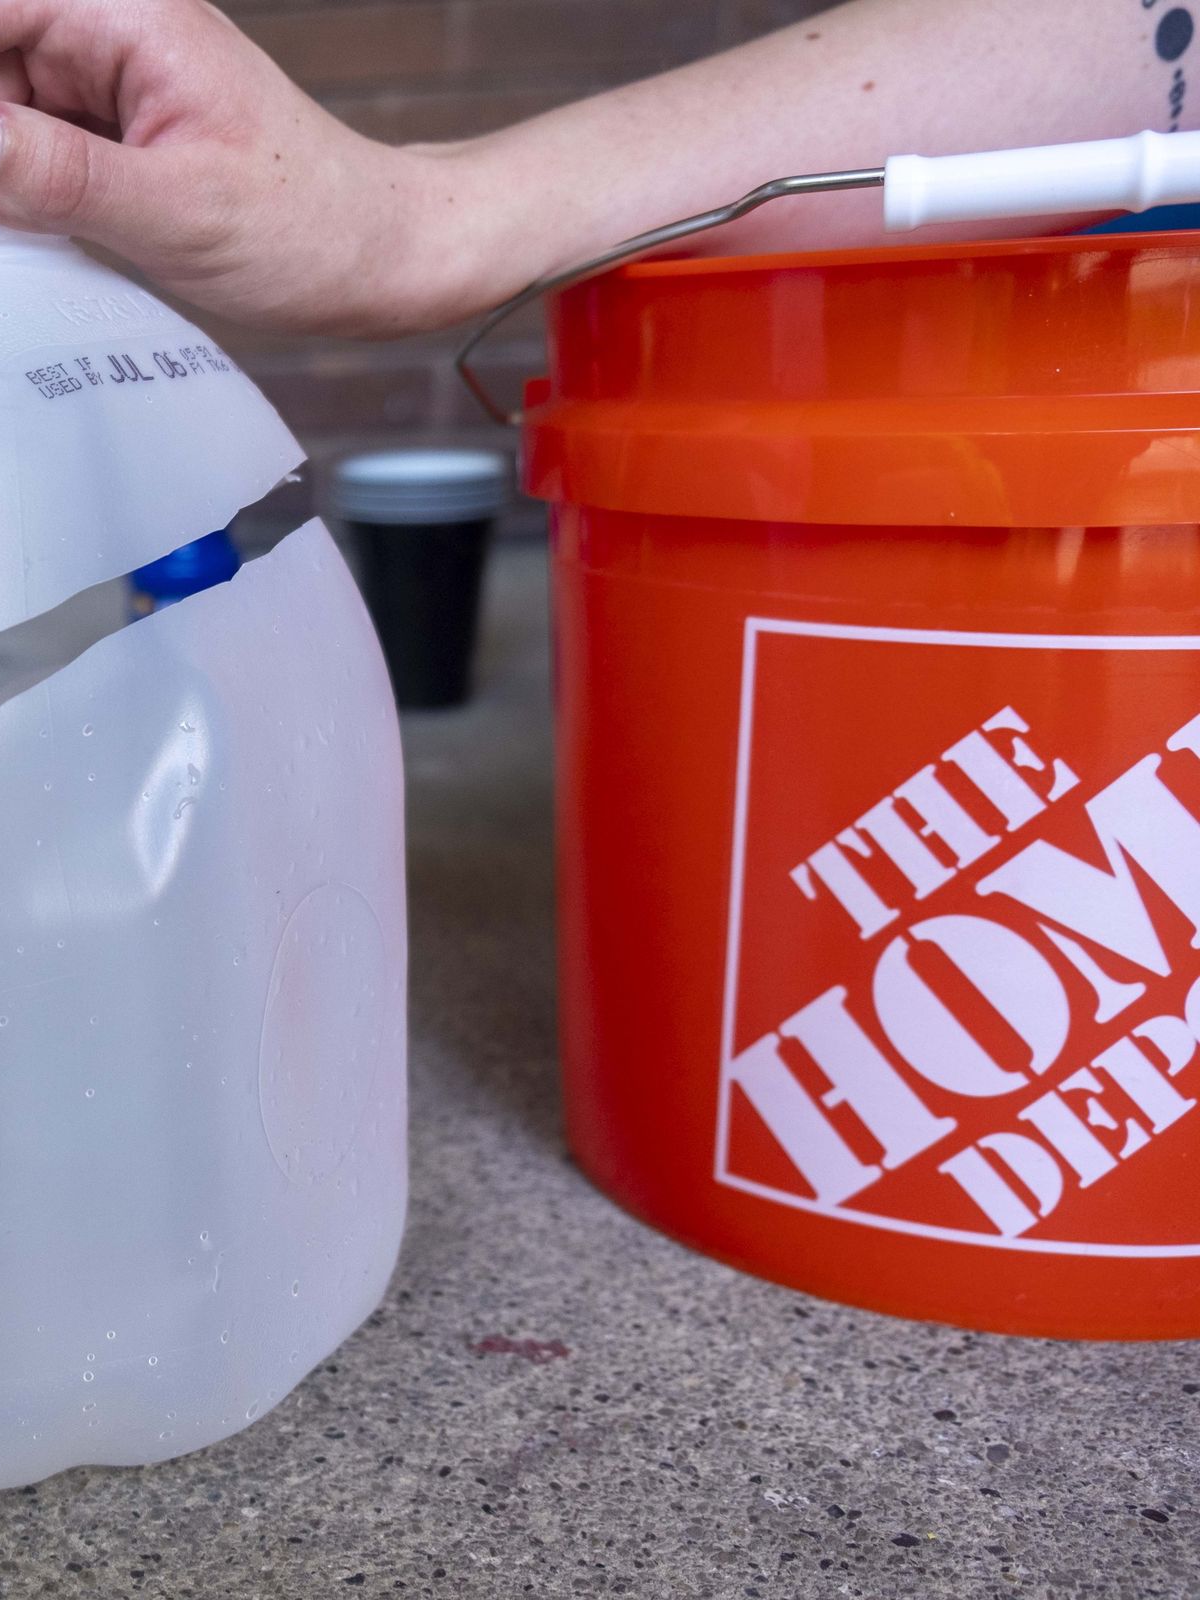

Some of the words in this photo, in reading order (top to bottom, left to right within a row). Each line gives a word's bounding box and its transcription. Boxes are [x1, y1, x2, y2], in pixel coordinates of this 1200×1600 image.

[24, 362, 69, 386] BEST
[73, 356, 92, 372] IF
[38, 376, 83, 400] USED
[85, 371, 105, 386] BY
[106, 353, 155, 384] JUL
[152, 351, 188, 379] 06
[788, 705, 1082, 941] THE
[728, 711, 1200, 1208] HOM
[937, 974, 1200, 1240] DEP
